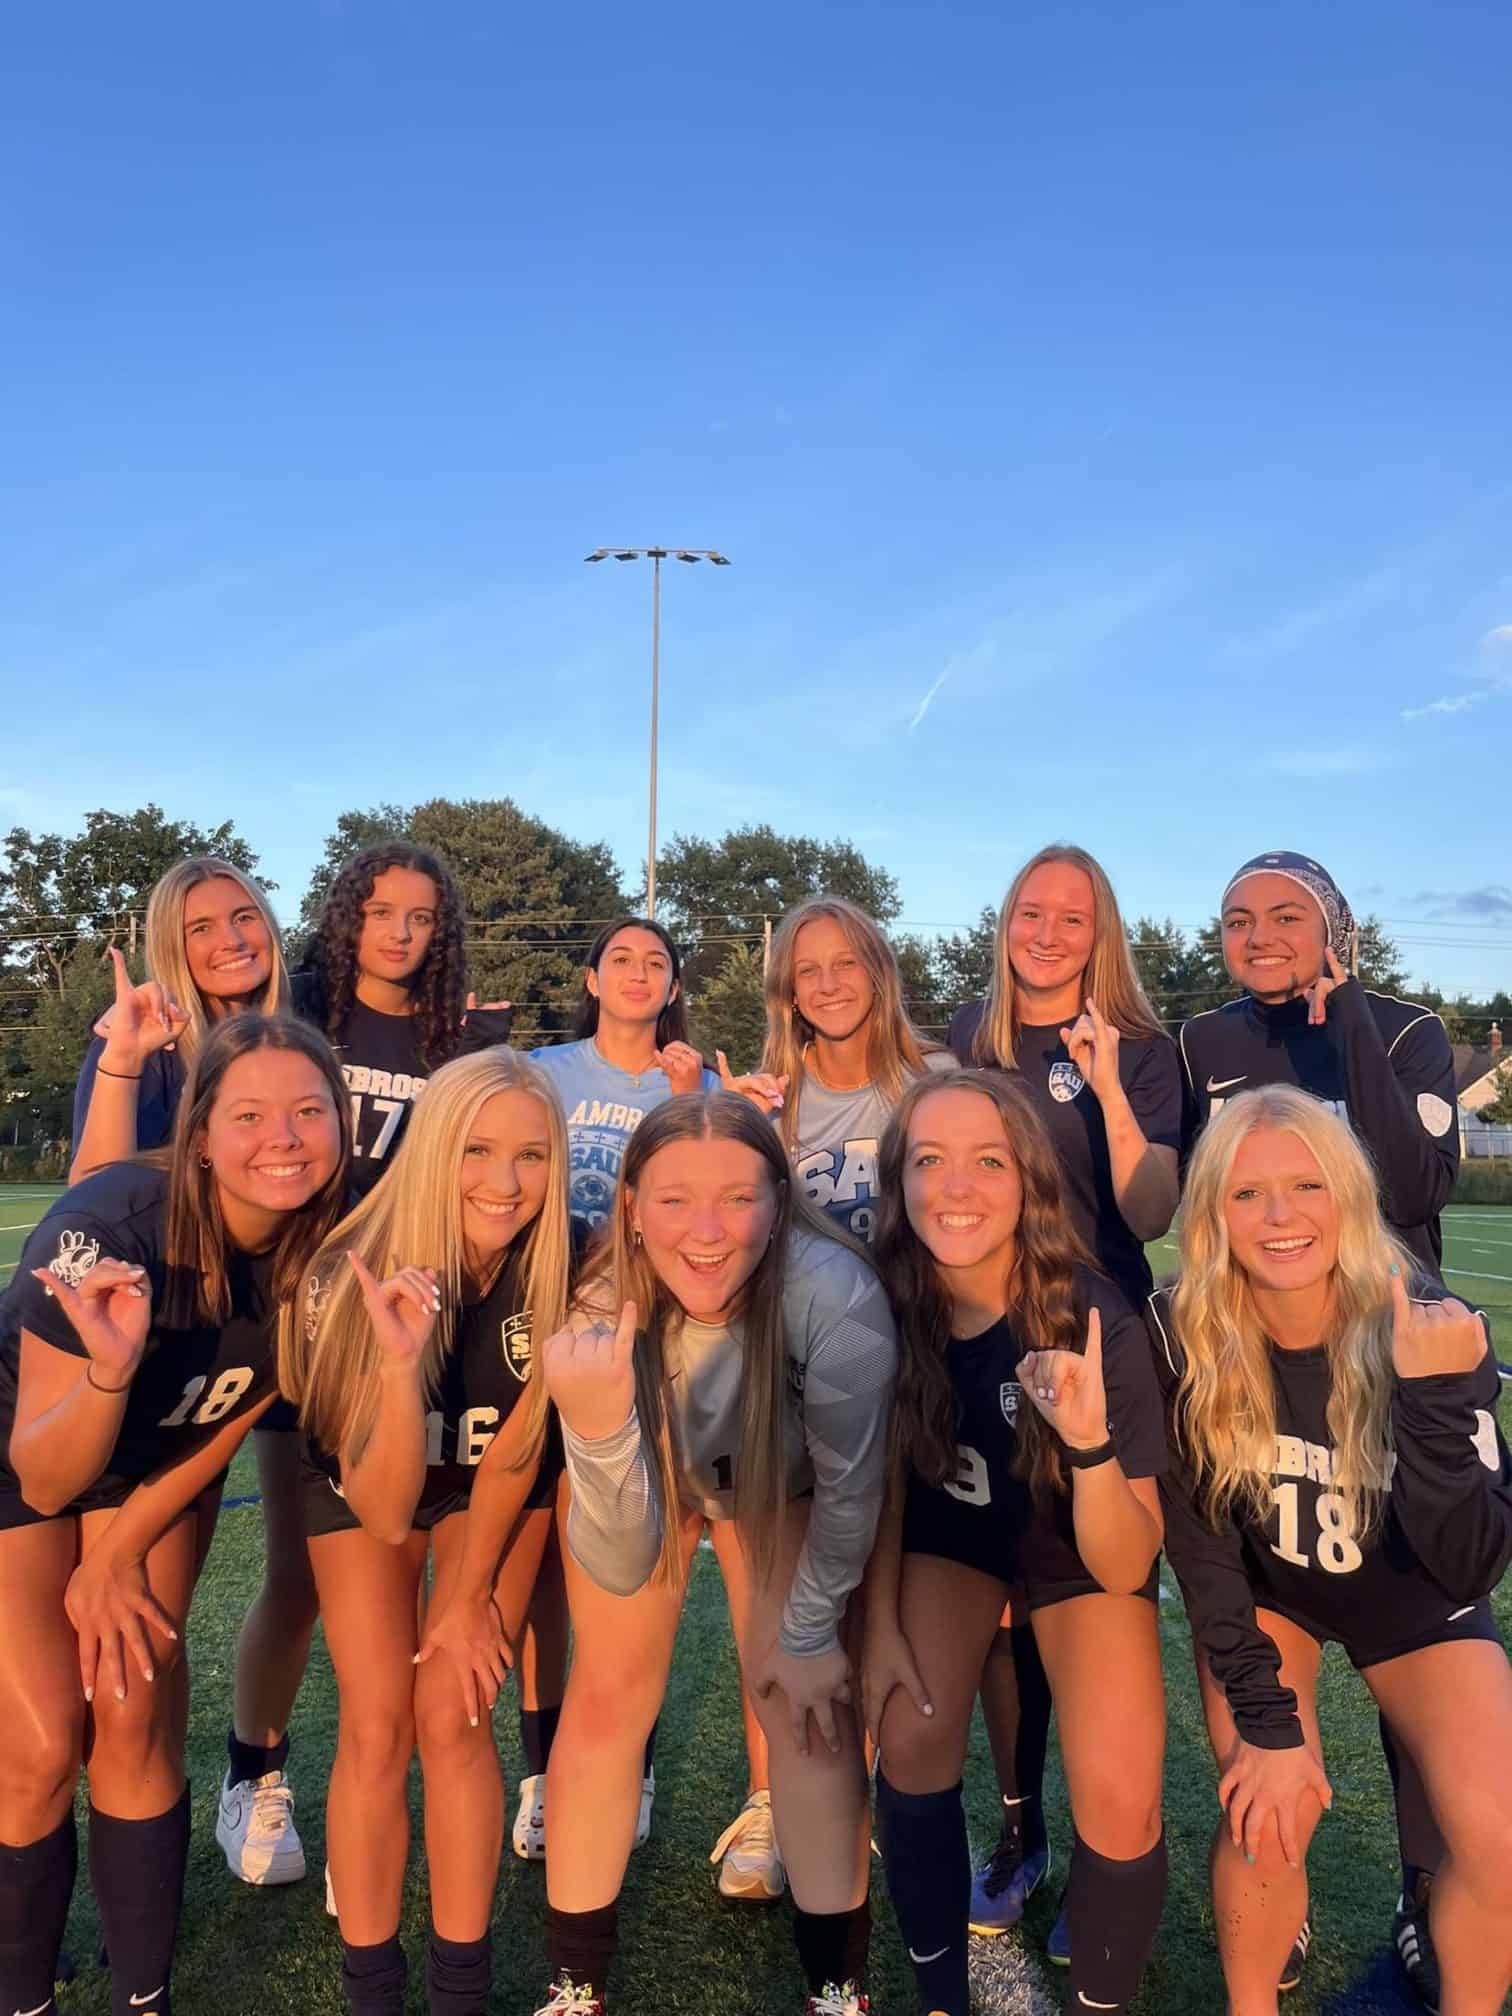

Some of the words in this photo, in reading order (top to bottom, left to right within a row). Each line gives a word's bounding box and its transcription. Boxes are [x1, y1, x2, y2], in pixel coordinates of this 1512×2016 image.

[158, 1366, 254, 1426] 18
[426, 1406, 499, 1466] 16
[1270, 1482, 1363, 1574] 18
